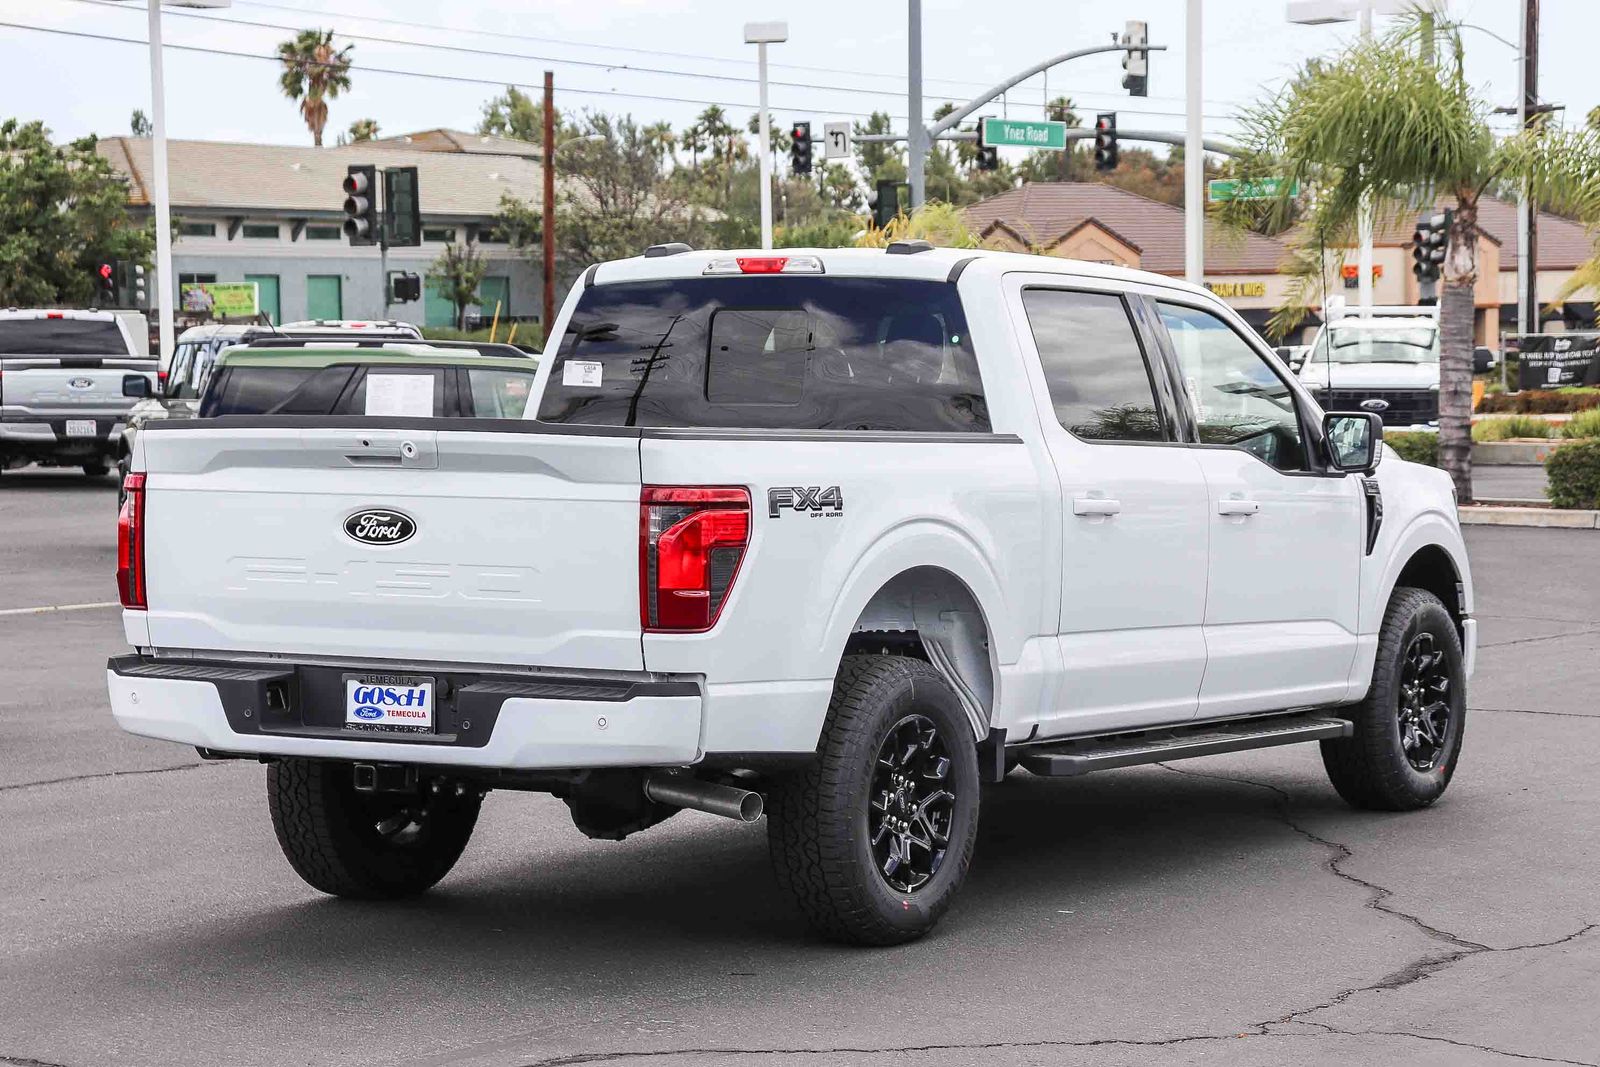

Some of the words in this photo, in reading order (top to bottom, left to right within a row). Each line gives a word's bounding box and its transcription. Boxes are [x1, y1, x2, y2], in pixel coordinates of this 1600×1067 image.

[1003, 124, 1024, 141] Ynez
[1025, 126, 1049, 143] Road
[767, 486, 843, 518] FX4
[355, 514, 402, 538] Ford
[366, 675, 414, 685] TEMECULA
[360, 707, 377, 718] Ford
[387, 710, 426, 718] TEMECULA
